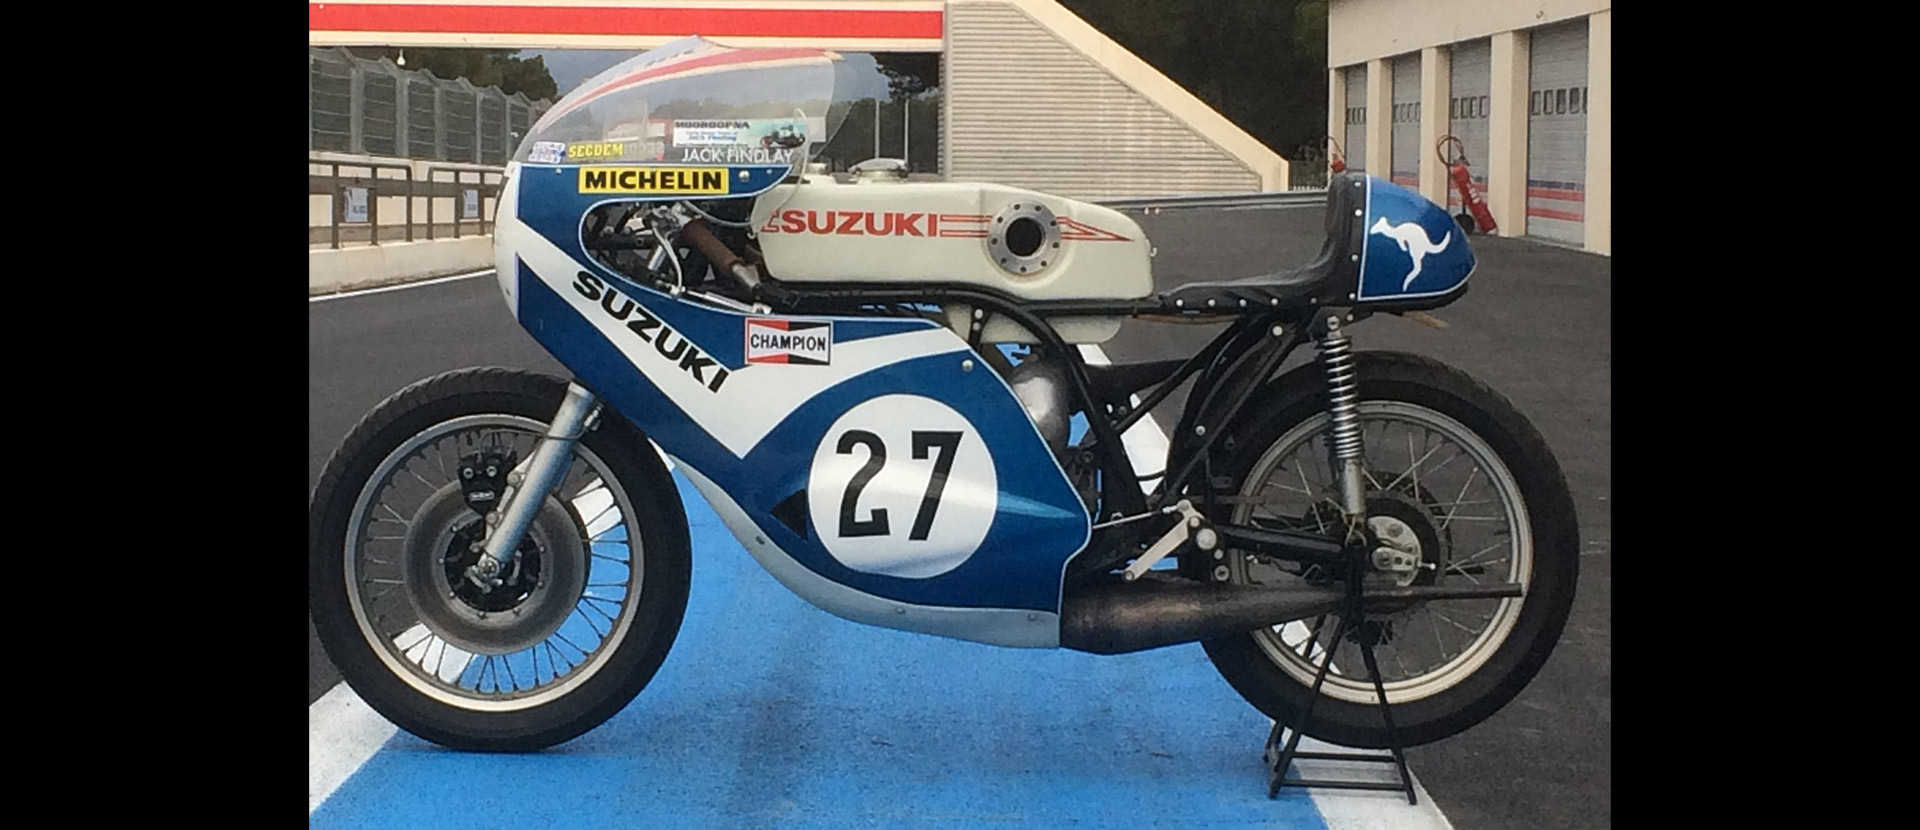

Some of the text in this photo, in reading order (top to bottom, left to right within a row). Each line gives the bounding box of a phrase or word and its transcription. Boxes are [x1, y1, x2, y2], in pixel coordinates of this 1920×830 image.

[568, 143, 624, 158] SECDEM
[681, 148, 794, 163] JACK FINDLAY
[584, 171, 722, 190] MICHELIN
[781, 209, 938, 237] SUZUKI
[572, 270, 729, 394] SUZUKI
[750, 333, 826, 352] CHAMPION
[836, 429, 964, 541] 27
